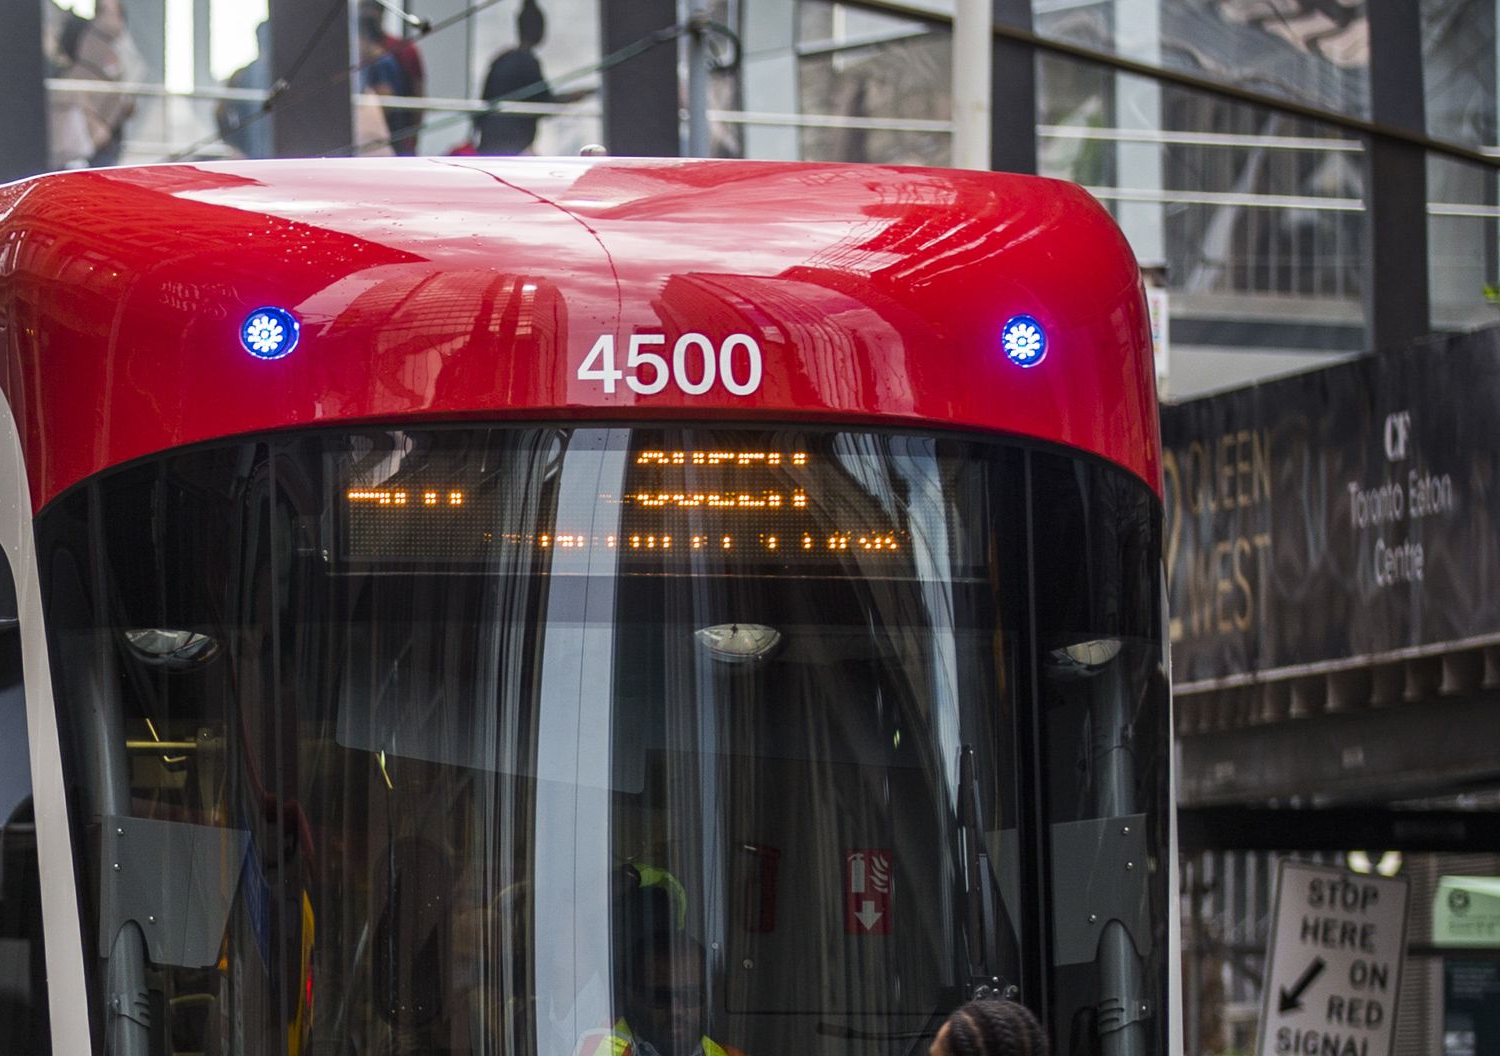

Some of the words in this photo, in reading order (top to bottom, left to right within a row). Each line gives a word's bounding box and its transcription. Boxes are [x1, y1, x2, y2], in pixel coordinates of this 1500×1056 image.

[577, 332, 763, 396] 4500
[1185, 430, 1271, 517] QUEEN
[1347, 478, 1405, 528] Toronto
[1408, 469, 1453, 519] Eaton
[1186, 532, 1272, 636] WEST
[1374, 537, 1425, 588] Centre
[1307, 877, 1379, 912] STOP
[1299, 914, 1375, 954] HERE
[1350, 958, 1388, 993] ON
[1326, 994, 1383, 1030] RED
